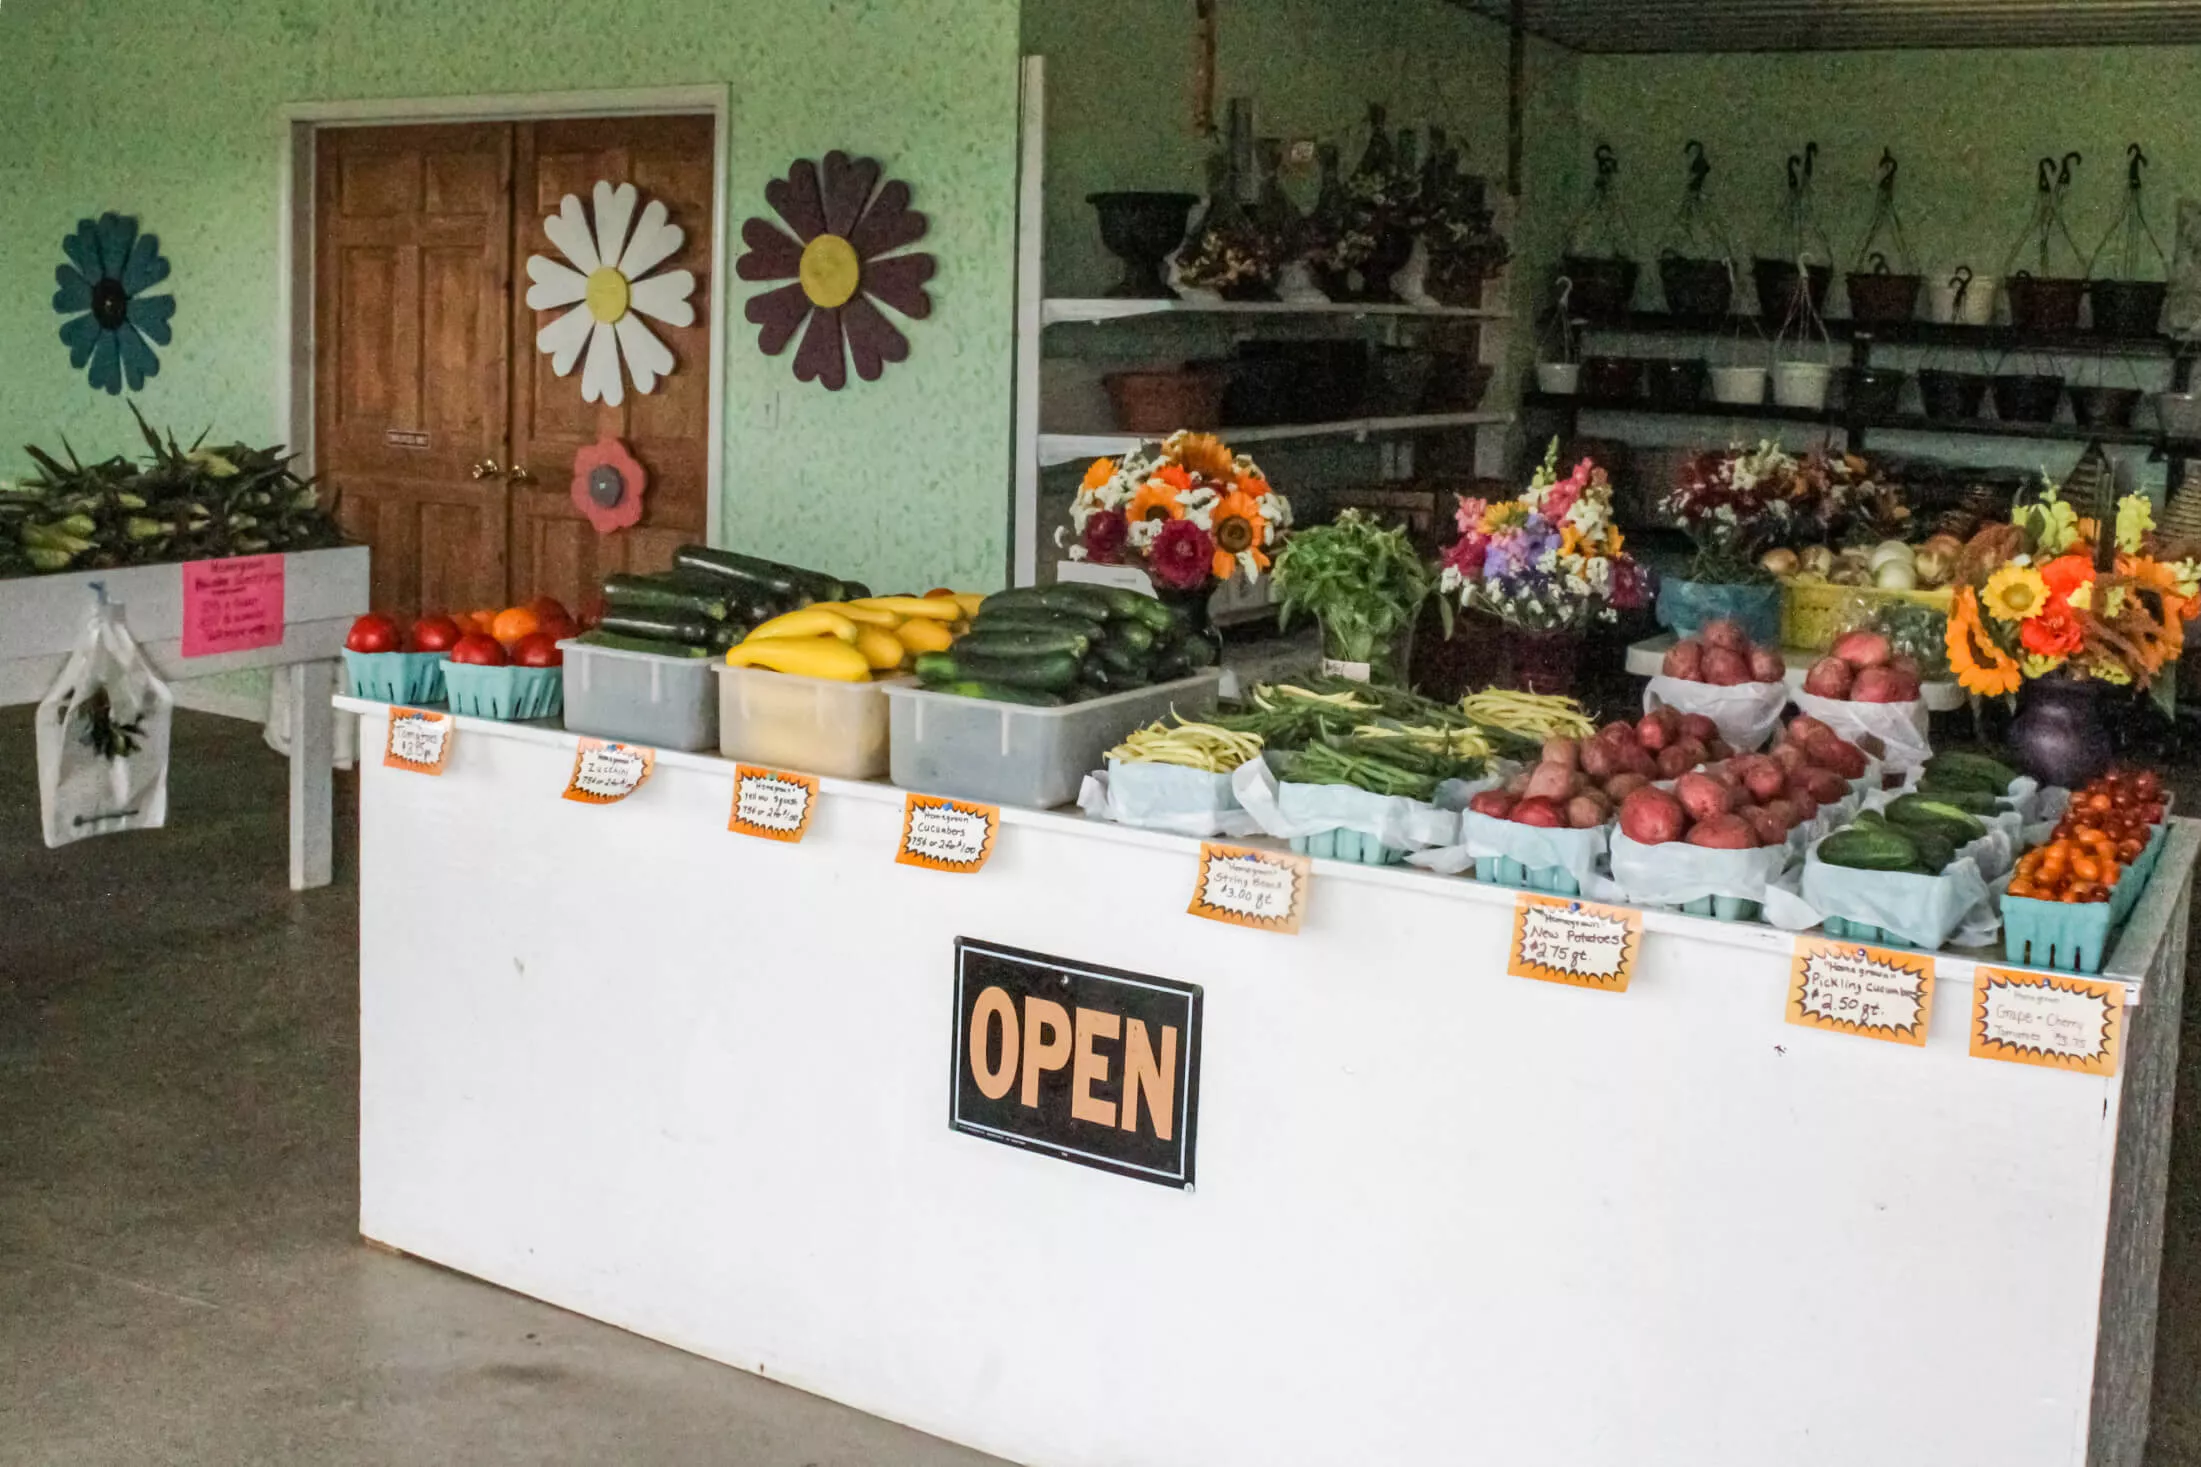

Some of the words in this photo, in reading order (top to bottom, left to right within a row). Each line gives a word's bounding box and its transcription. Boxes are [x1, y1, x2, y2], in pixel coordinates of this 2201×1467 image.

[1529, 925, 1560, 940] New
[1566, 930, 1620, 945] Potatoes
[1811, 972, 1862, 995] Pickling
[1810, 988, 1859, 1011] $2.50
[1996, 1004, 2033, 1024] Grape
[2046, 1013, 2084, 1031] Cherry
[969, 986, 1178, 1141] OPEN
